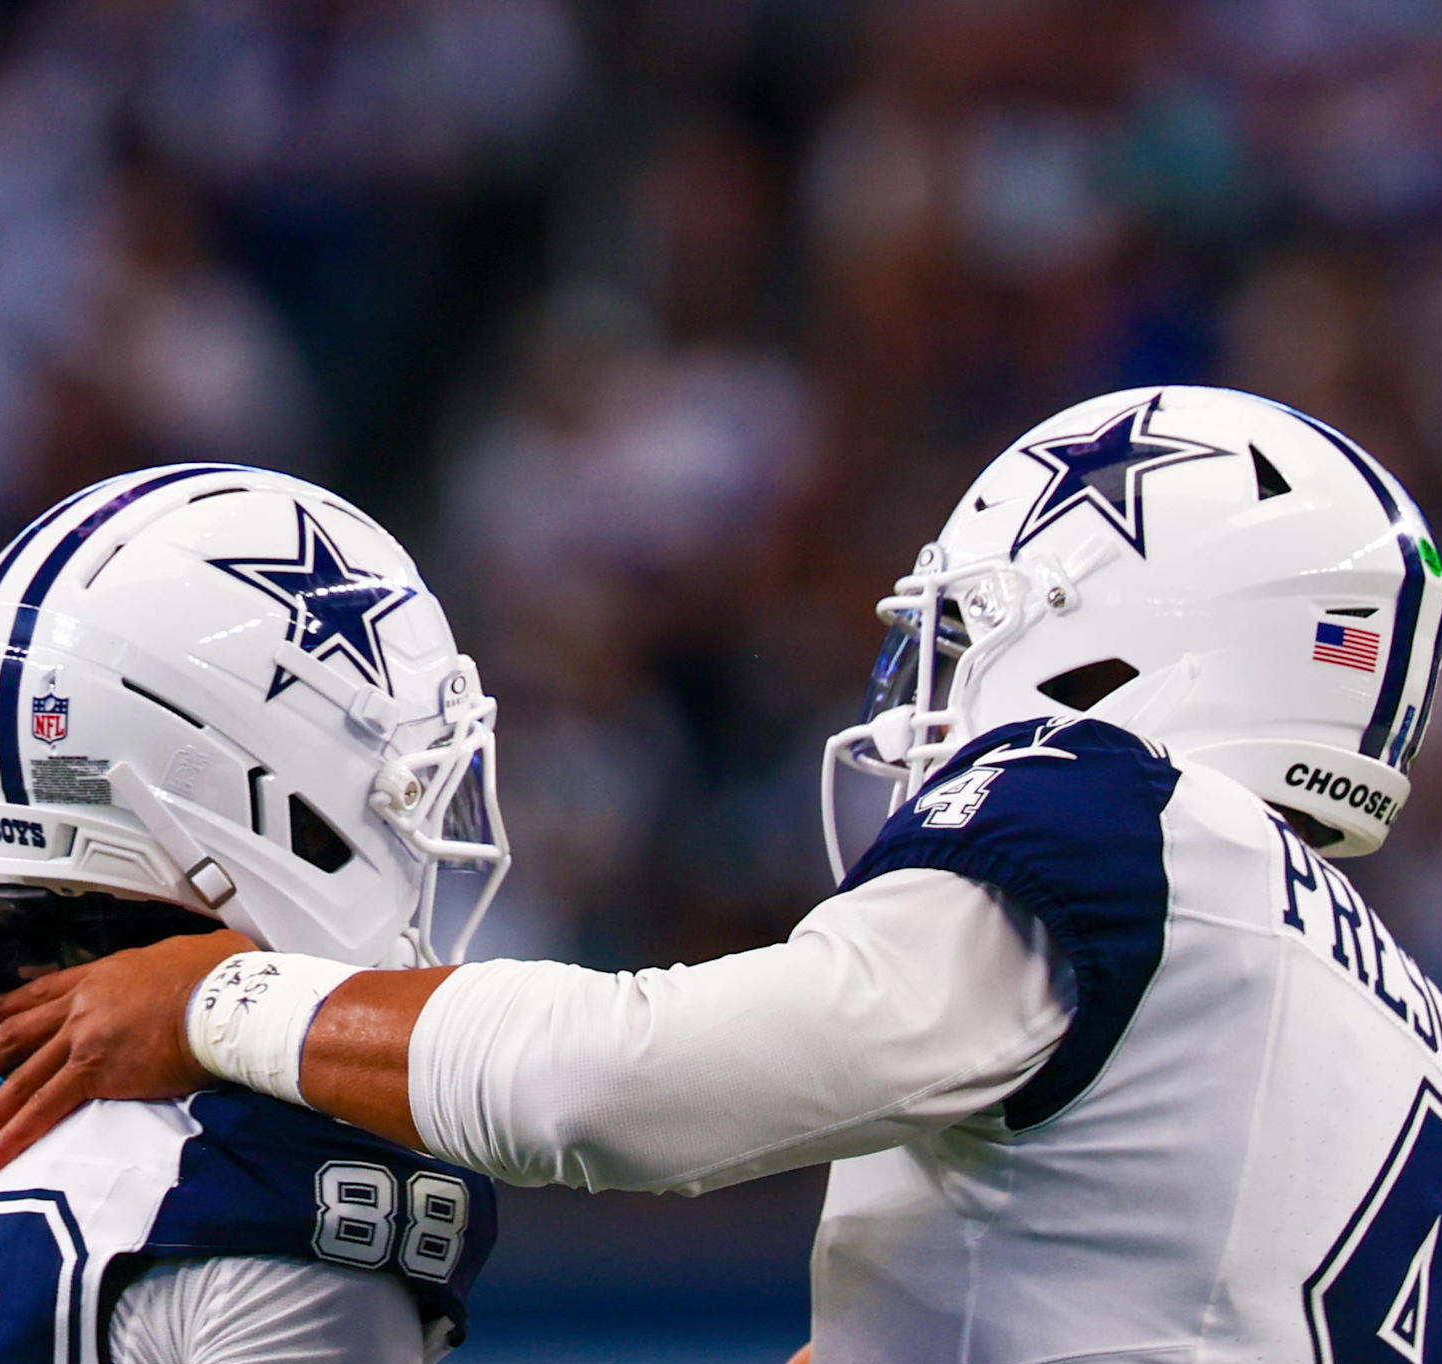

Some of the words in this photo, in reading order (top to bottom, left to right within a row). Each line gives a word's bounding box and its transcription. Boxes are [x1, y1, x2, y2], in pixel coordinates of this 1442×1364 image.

[34, 715, 66, 739] NFL
[914, 766, 1005, 829] 4
[1285, 763, 1393, 821] CHOOSE
[311, 1160, 470, 1284] 88
